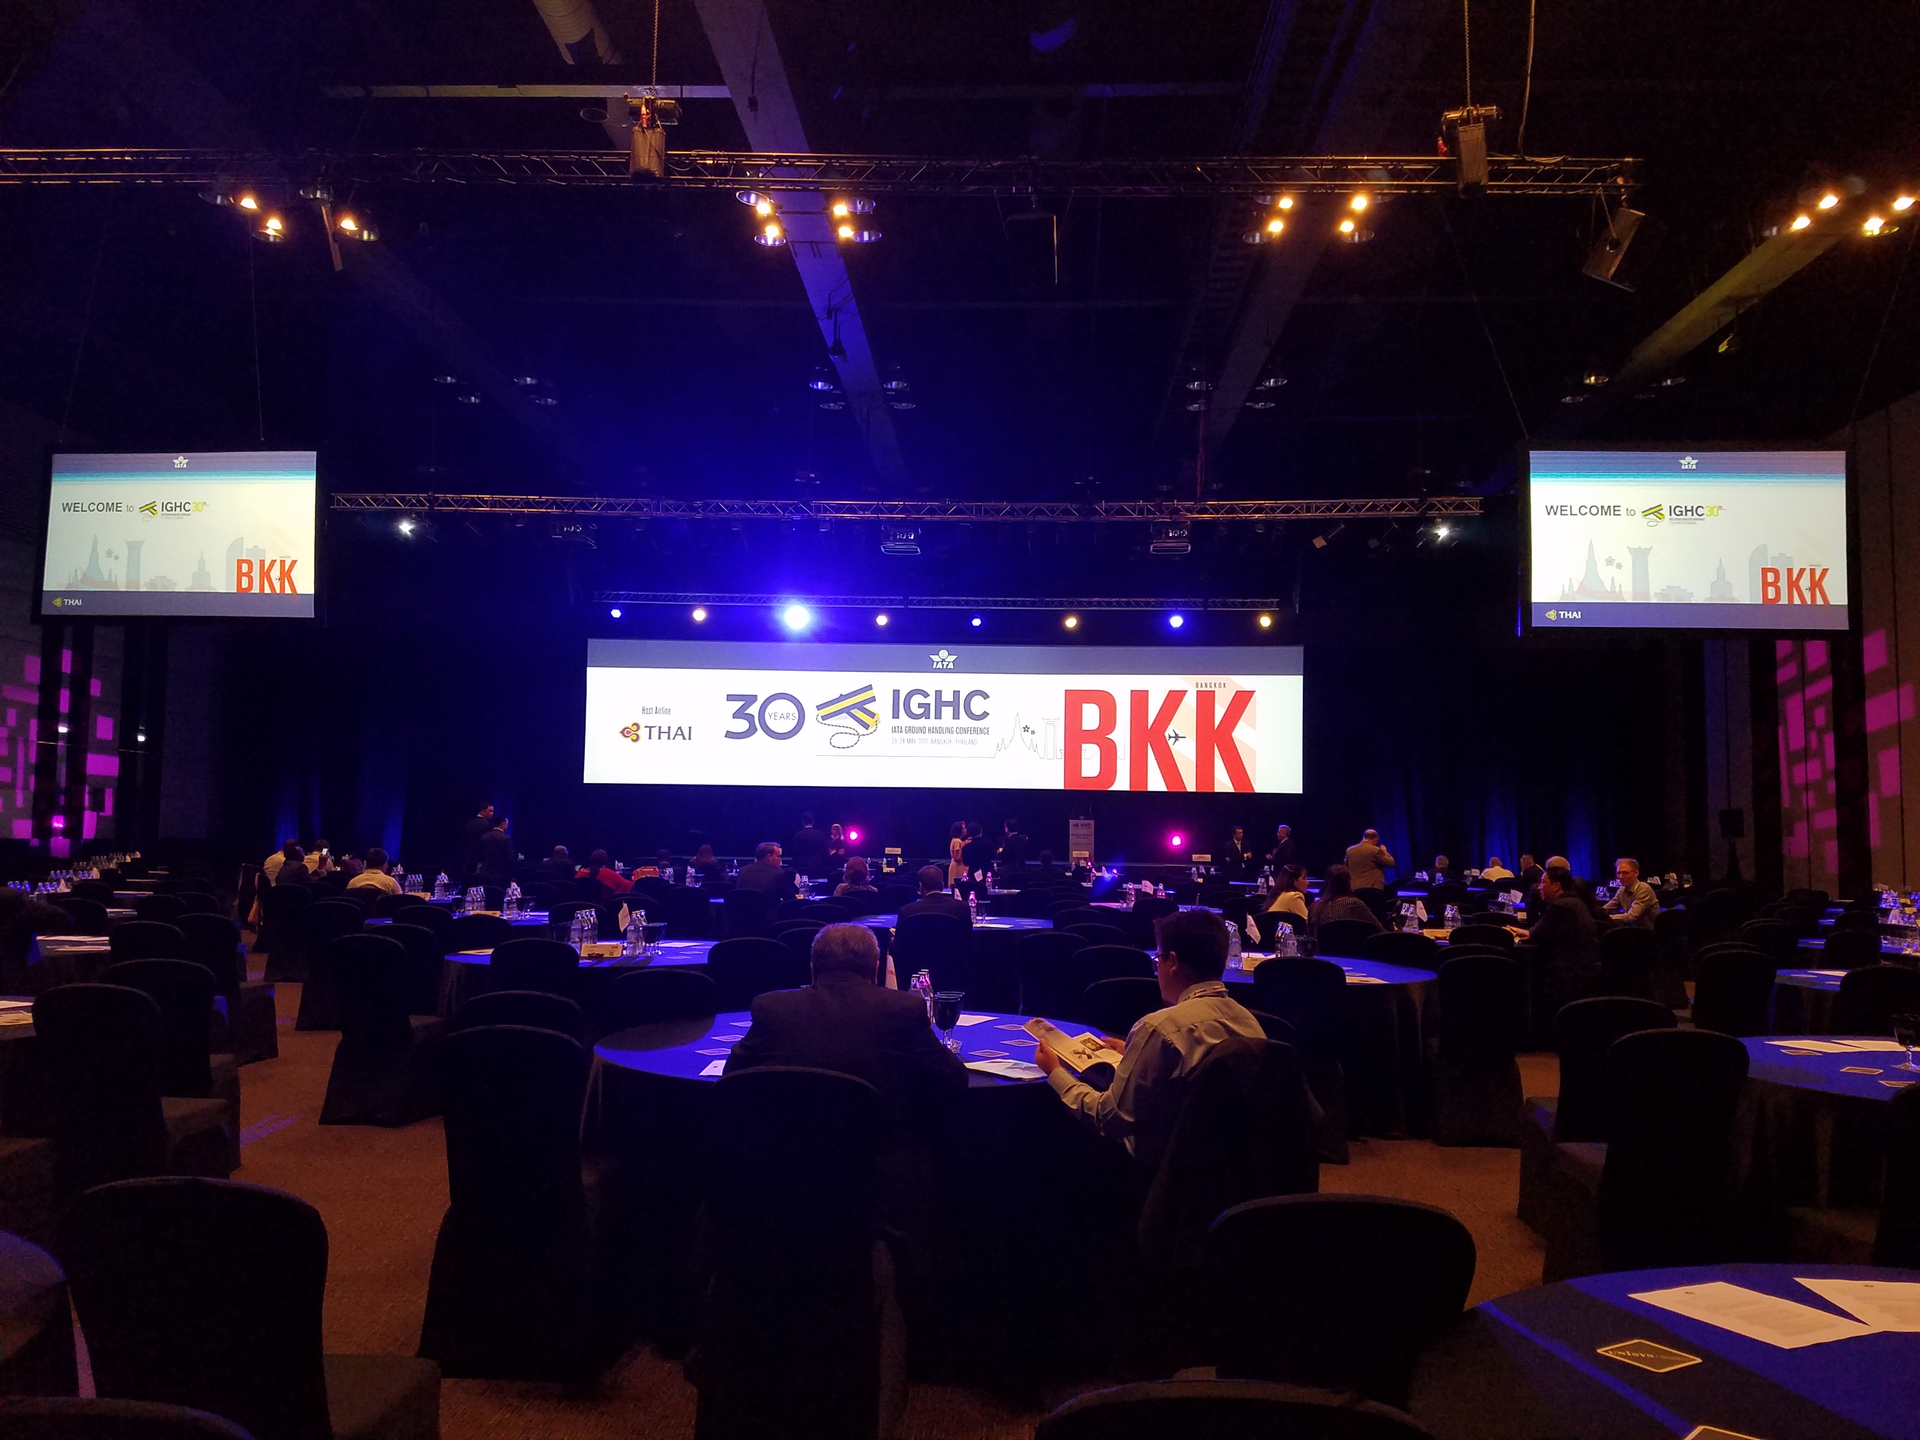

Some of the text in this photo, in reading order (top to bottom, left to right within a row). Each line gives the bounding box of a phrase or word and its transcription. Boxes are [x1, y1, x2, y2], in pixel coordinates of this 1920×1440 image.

[62, 502, 123, 512] WELCOME
[161, 501, 191, 512] IGHC
[1545, 505, 1621, 516] WELCOME
[1626, 507, 1636, 516] to
[1669, 505, 1705, 517] IGHC
[236, 558, 298, 594] BKK
[1761, 567, 1831, 605] BKK
[63, 598, 82, 606] THAI
[1559, 611, 1581, 619] THAI
[932, 661, 954, 669] IATA
[1195, 681, 1227, 689] BANGKOK
[892, 688, 990, 721] IGHC
[641, 706, 654, 715] Host
[724, 692, 806, 740] 30
[767, 712, 797, 721] YEARS
[644, 725, 692, 740] THAI
[891, 725, 990, 736] IATA GROUND HANDLING CONFERENCE
[1064, 689, 1257, 792] BKK
